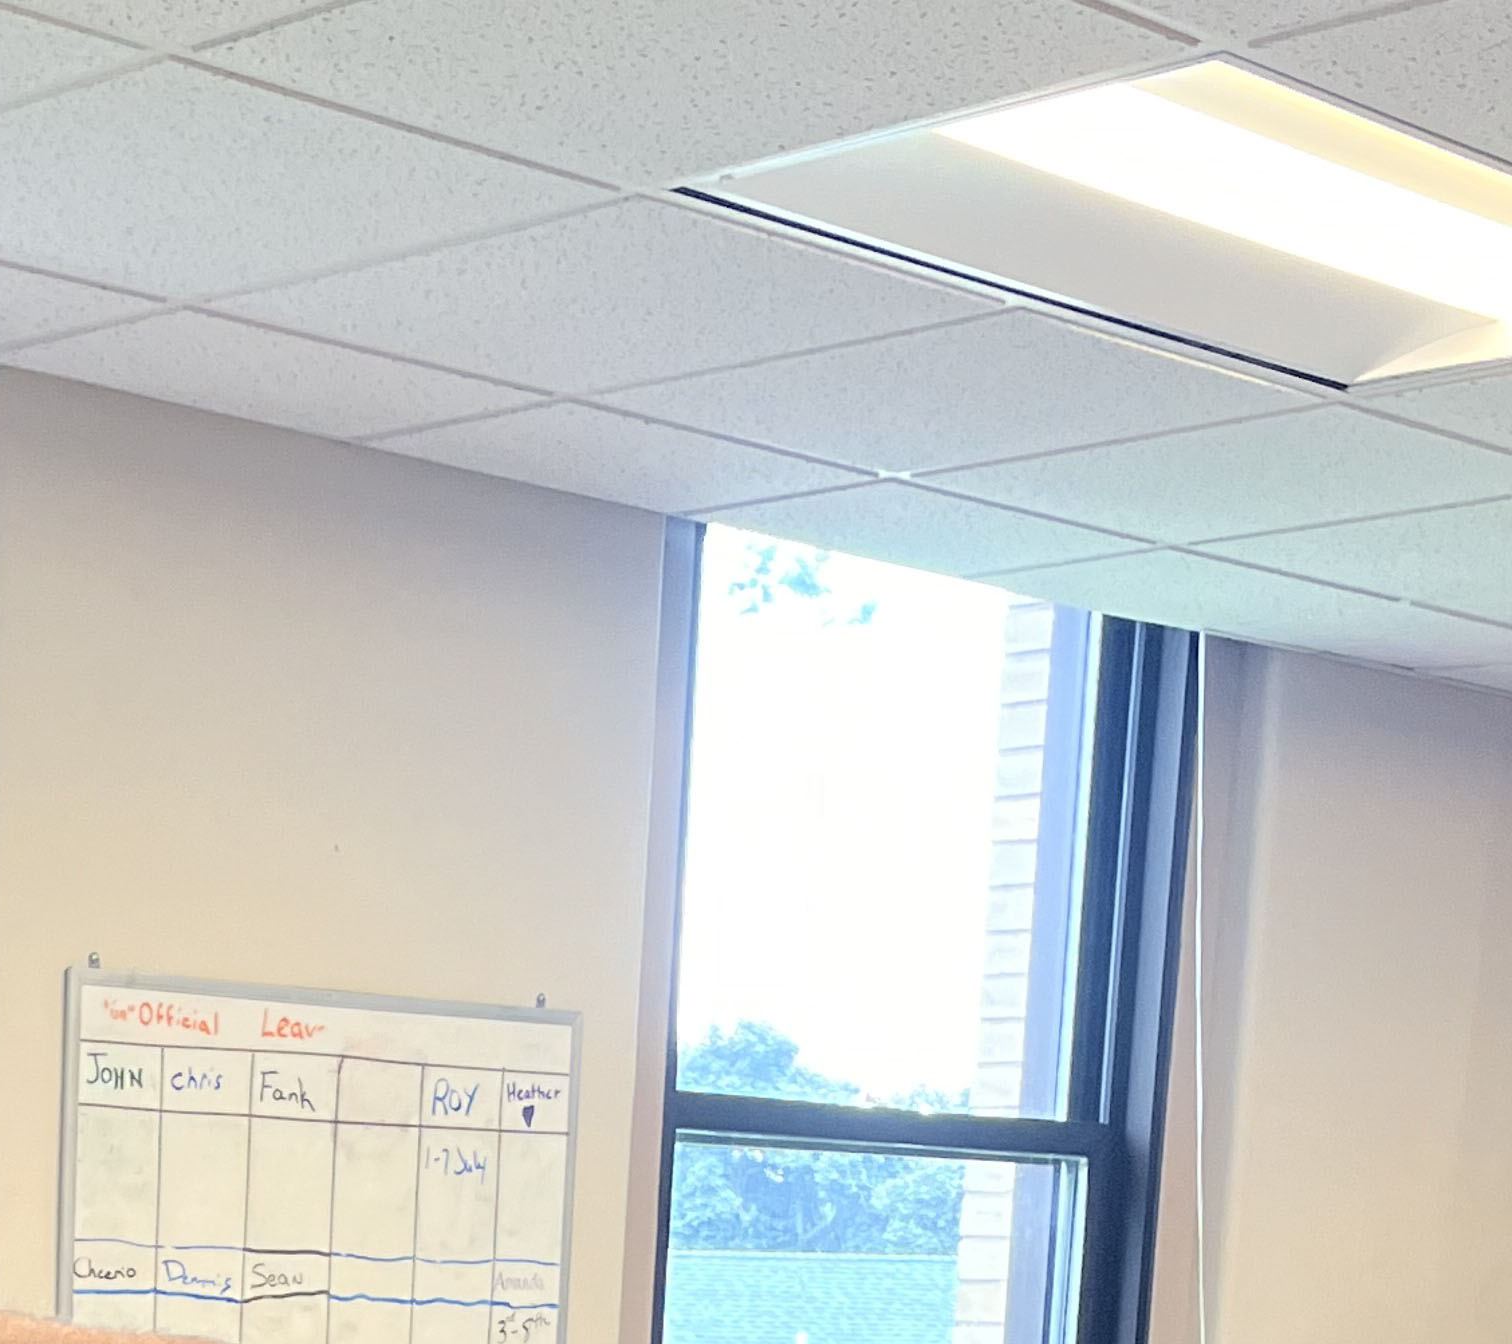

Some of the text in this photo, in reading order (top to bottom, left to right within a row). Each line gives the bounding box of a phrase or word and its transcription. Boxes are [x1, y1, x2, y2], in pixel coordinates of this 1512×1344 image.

[86, 1052, 144, 1090] JOHN
[432, 1078, 479, 1115] ROY
[507, 1082, 561, 1102] Heather
